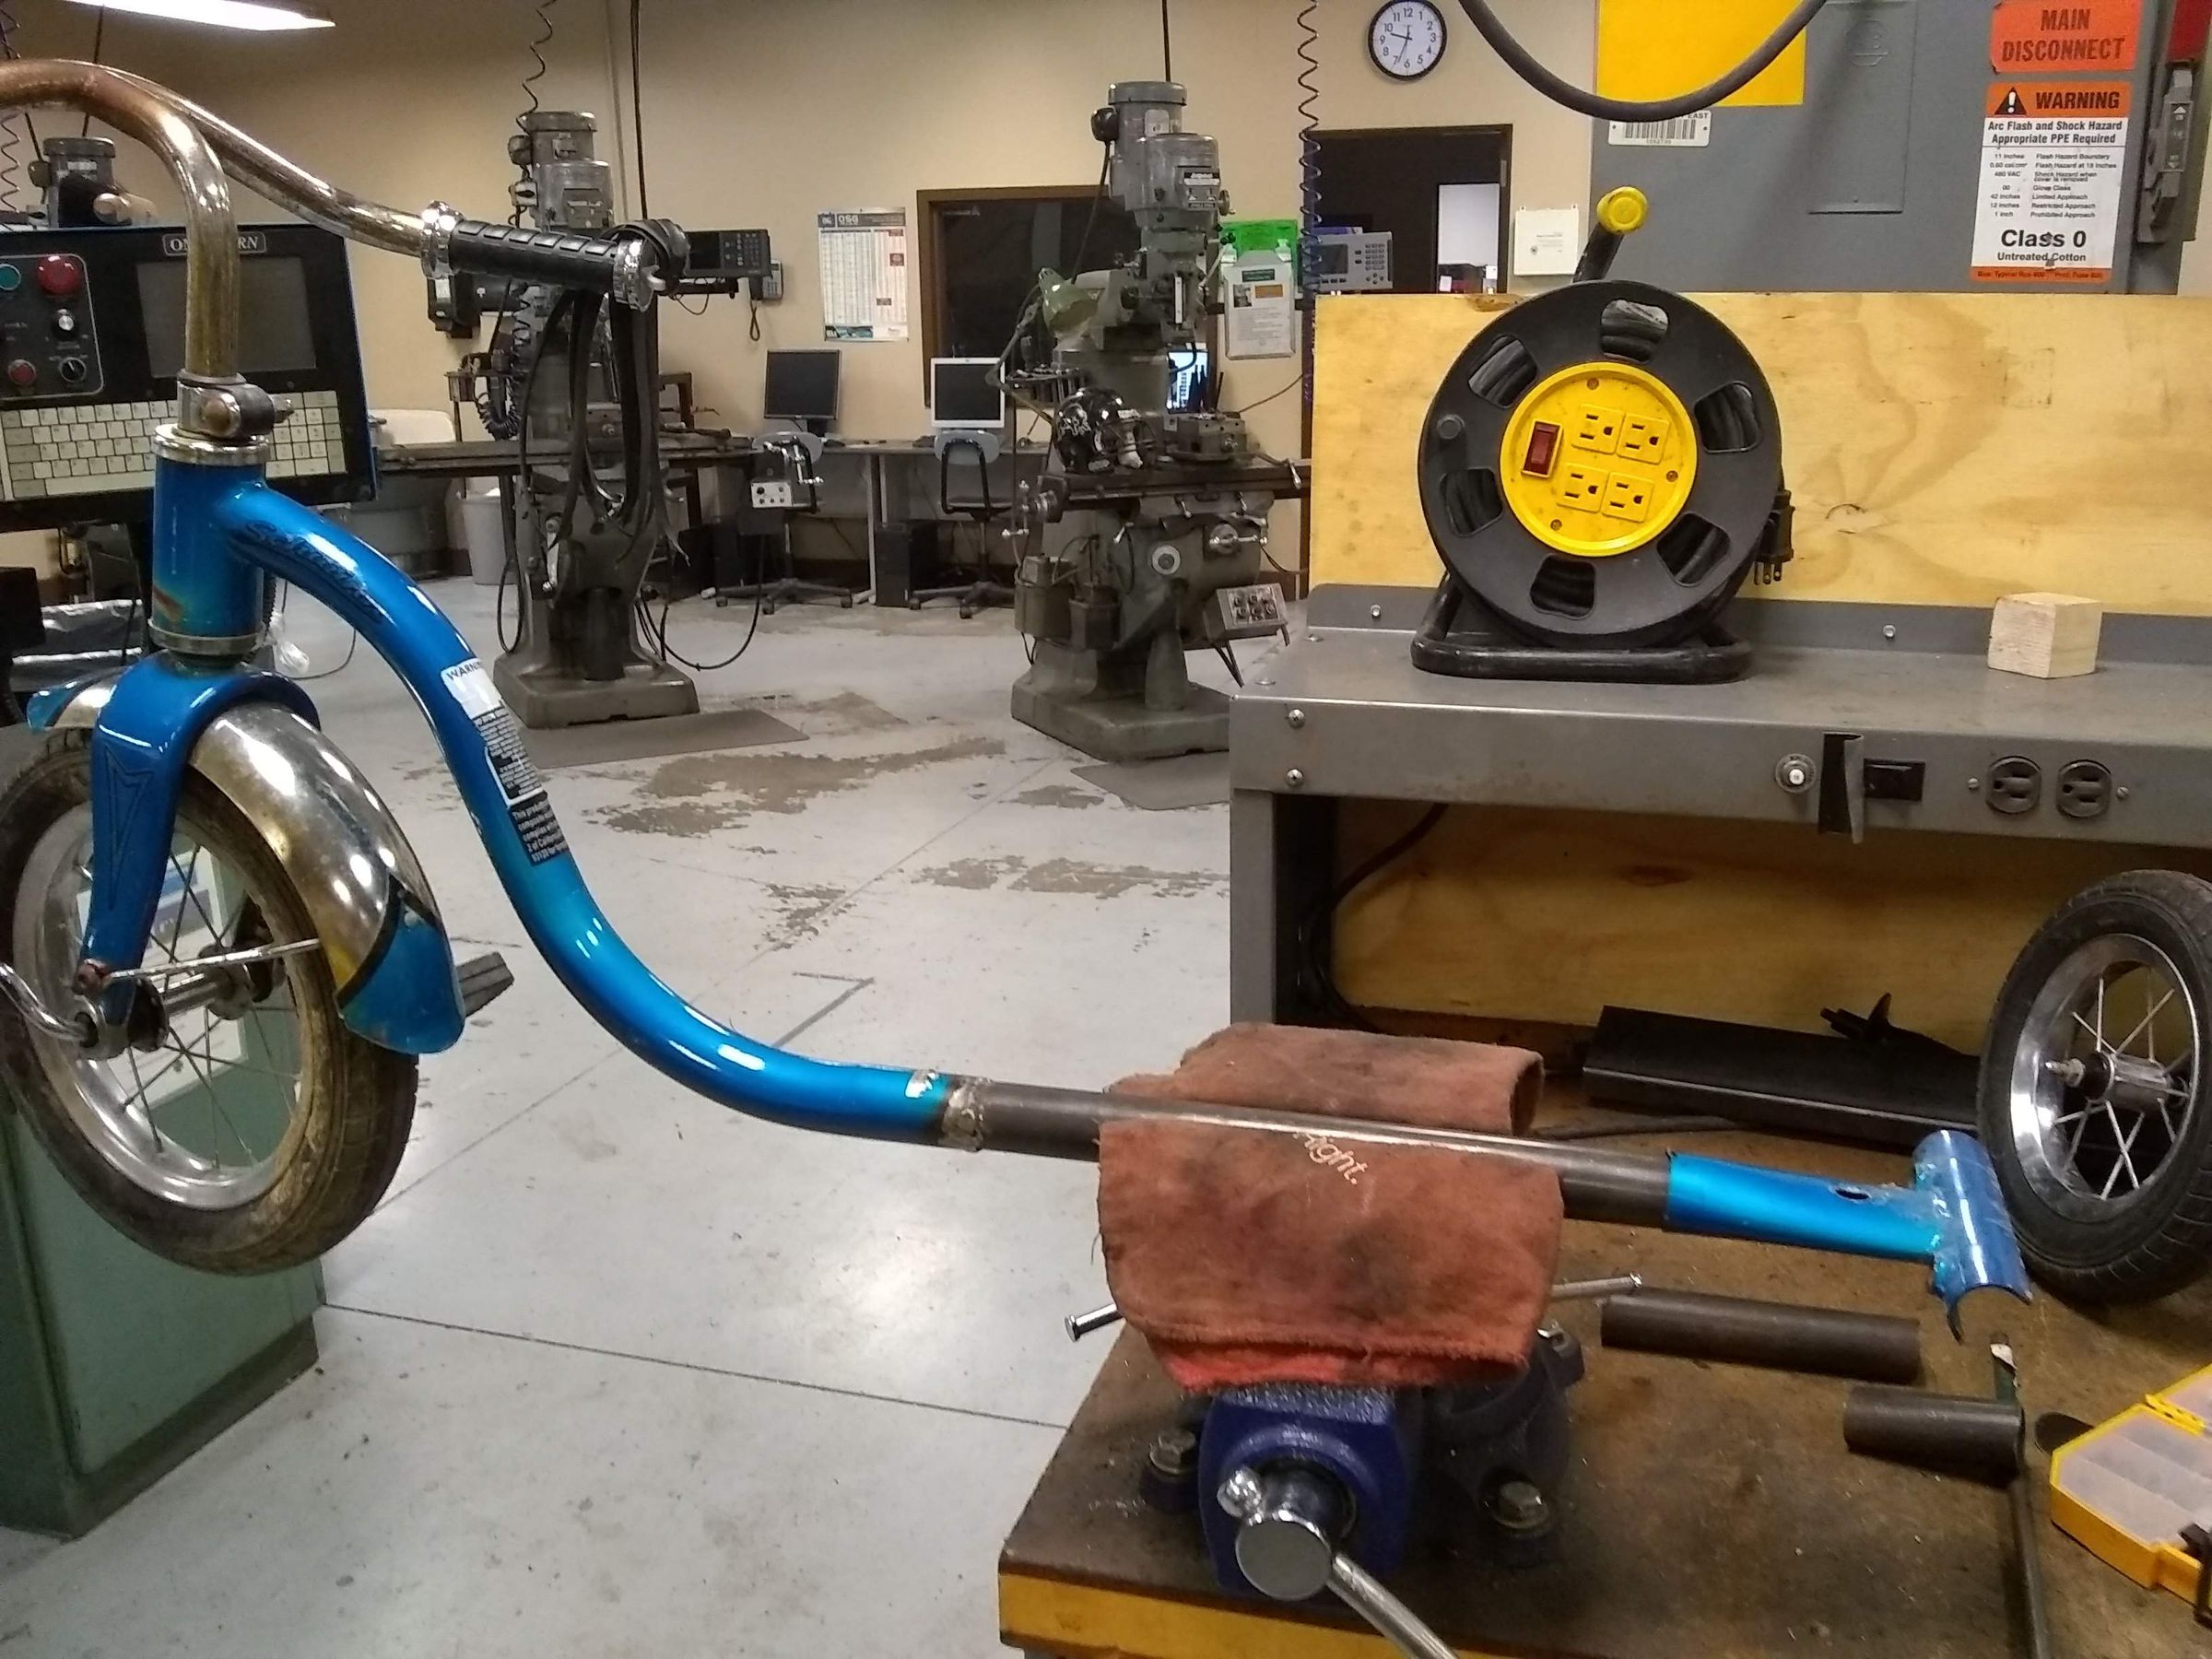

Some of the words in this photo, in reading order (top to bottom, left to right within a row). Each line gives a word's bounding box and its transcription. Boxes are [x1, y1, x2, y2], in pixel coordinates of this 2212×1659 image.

[1393, 12, 1400, 22] 11
[1403, 7, 1414, 18] 12
[1419, 11, 1423, 20] 1
[2040, 8, 2091, 31] MAIN
[1384, 22, 1394, 32] 10
[1427, 20, 1433, 30] 2
[1379, 34, 1386, 44] 9
[1430, 32, 1437, 42] 3
[1382, 46, 1389, 56] 8
[1426, 44, 1432, 54] 4
[2001, 38, 2125, 62] DISCONNECT
[1393, 55, 1398, 65] 7
[1404, 58, 1410, 68] 6
[1417, 54, 1424, 65] 5
[2035, 91, 2120, 110] WARNING
[1988, 121, 2005, 130] Arc
[2006, 121, 2033, 130] Flash
[2035, 121, 2053, 130] and
[2056, 121, 2086, 130] Shock
[2088, 121, 2123, 130] Hazard
[1992, 134, 2048, 145] Appropriate
[2051, 134, 2070, 143] PPE
[2072, 134, 2117, 145] Required
[2000, 229, 2065, 247] Class
[2073, 230, 2087, 248] 0
[1997, 253, 2048, 261] Untreated
[2051, 253, 2087, 262] Cotton
